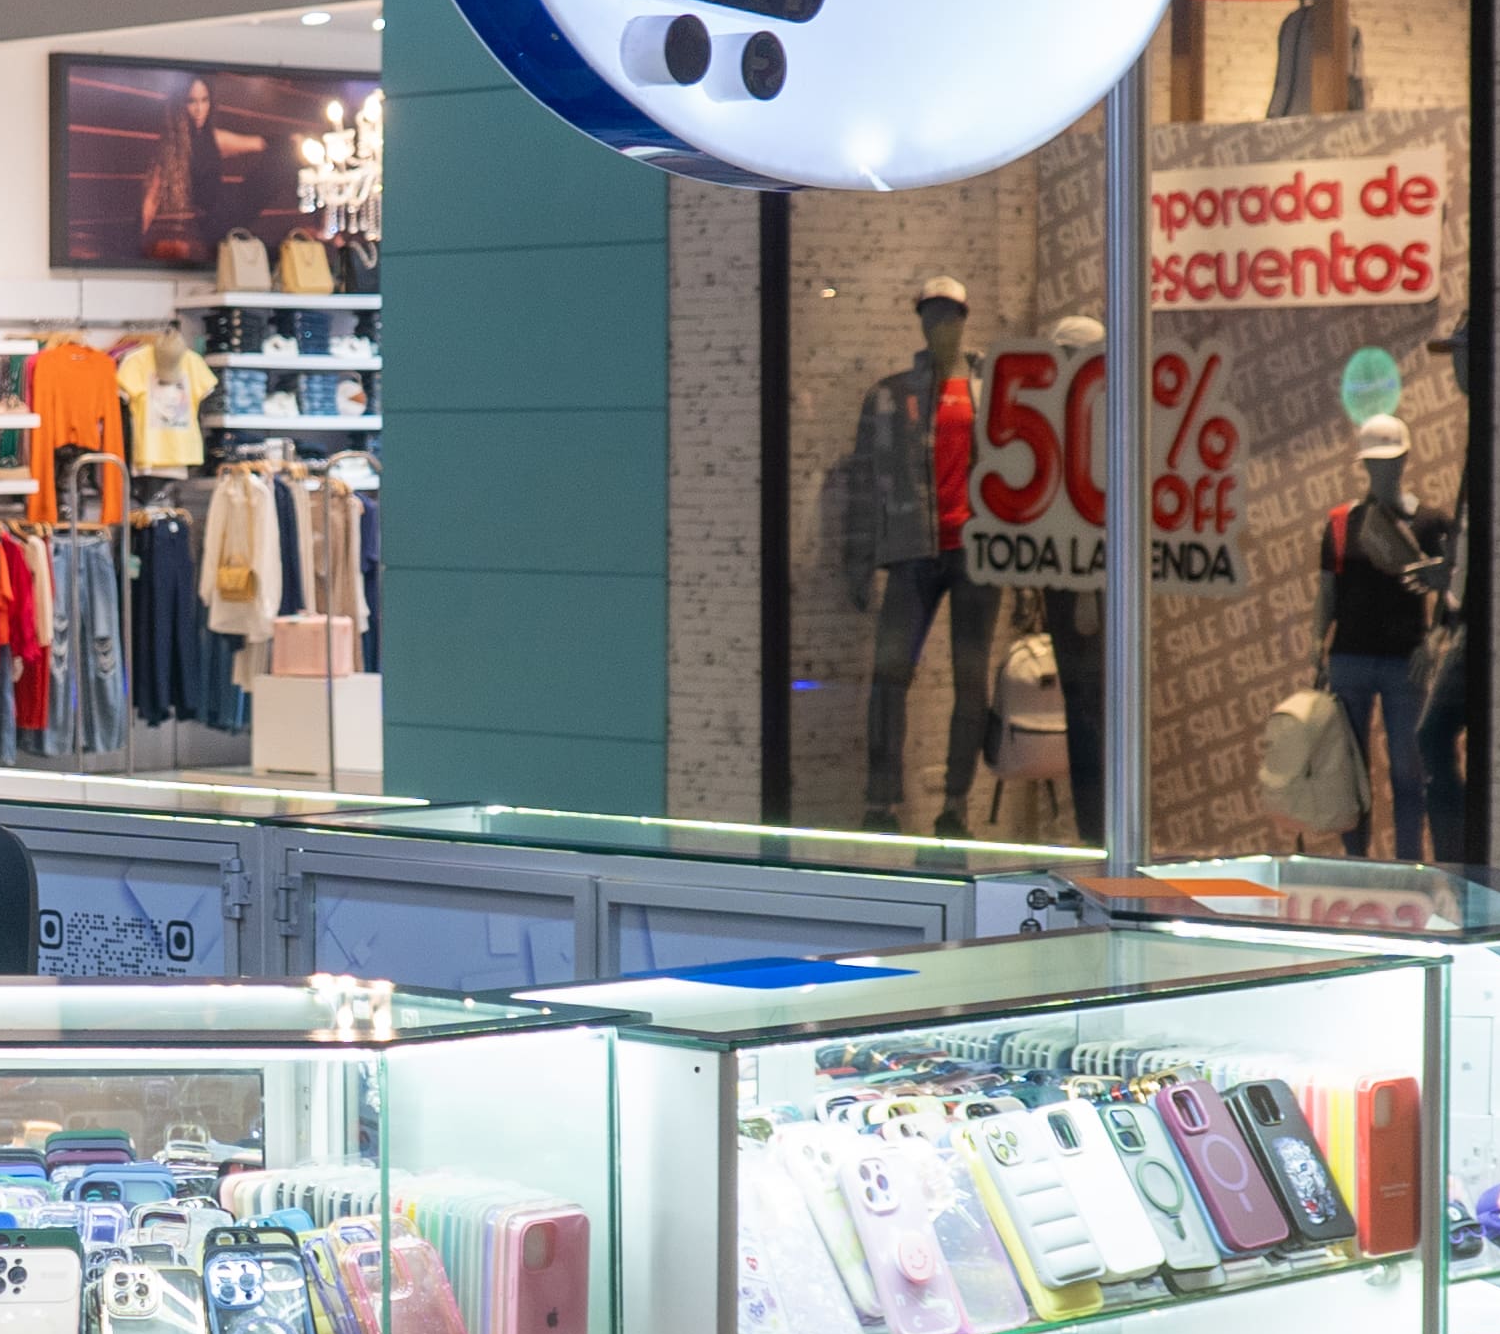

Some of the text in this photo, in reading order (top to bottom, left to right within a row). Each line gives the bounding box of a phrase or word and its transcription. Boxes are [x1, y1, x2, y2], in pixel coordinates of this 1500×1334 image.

[1151, 164, 1440, 242] porada de
[1152, 475, 1236, 535] OFF
[972, 531, 1055, 572] TODA
[1151, 539, 1237, 584] ENDA
